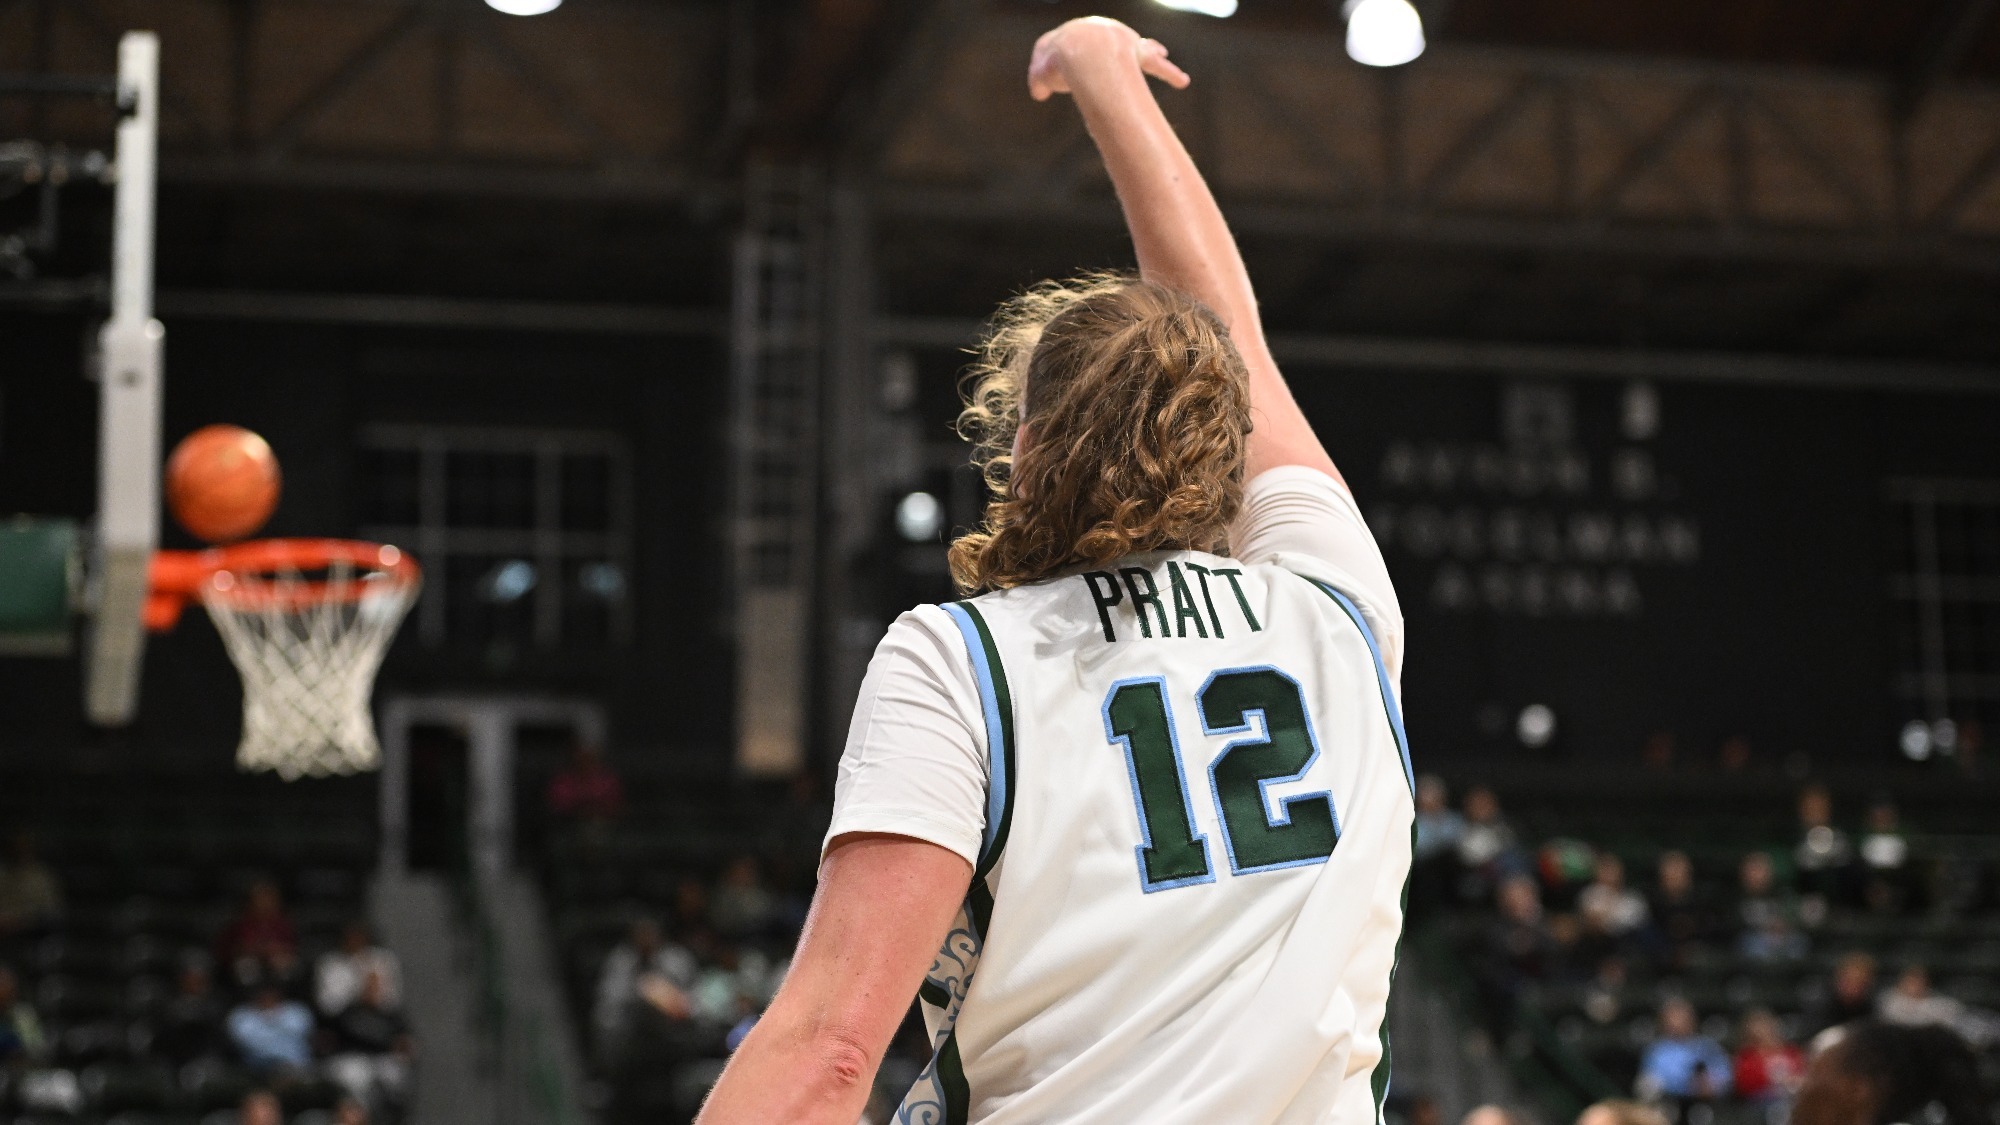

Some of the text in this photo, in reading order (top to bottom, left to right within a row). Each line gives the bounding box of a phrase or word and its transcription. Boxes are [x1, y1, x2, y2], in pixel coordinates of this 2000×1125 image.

[1082, 561, 1262, 642] PRATT
[1434, 564, 1640, 613] ARENA
[1101, 664, 1341, 893] 12
